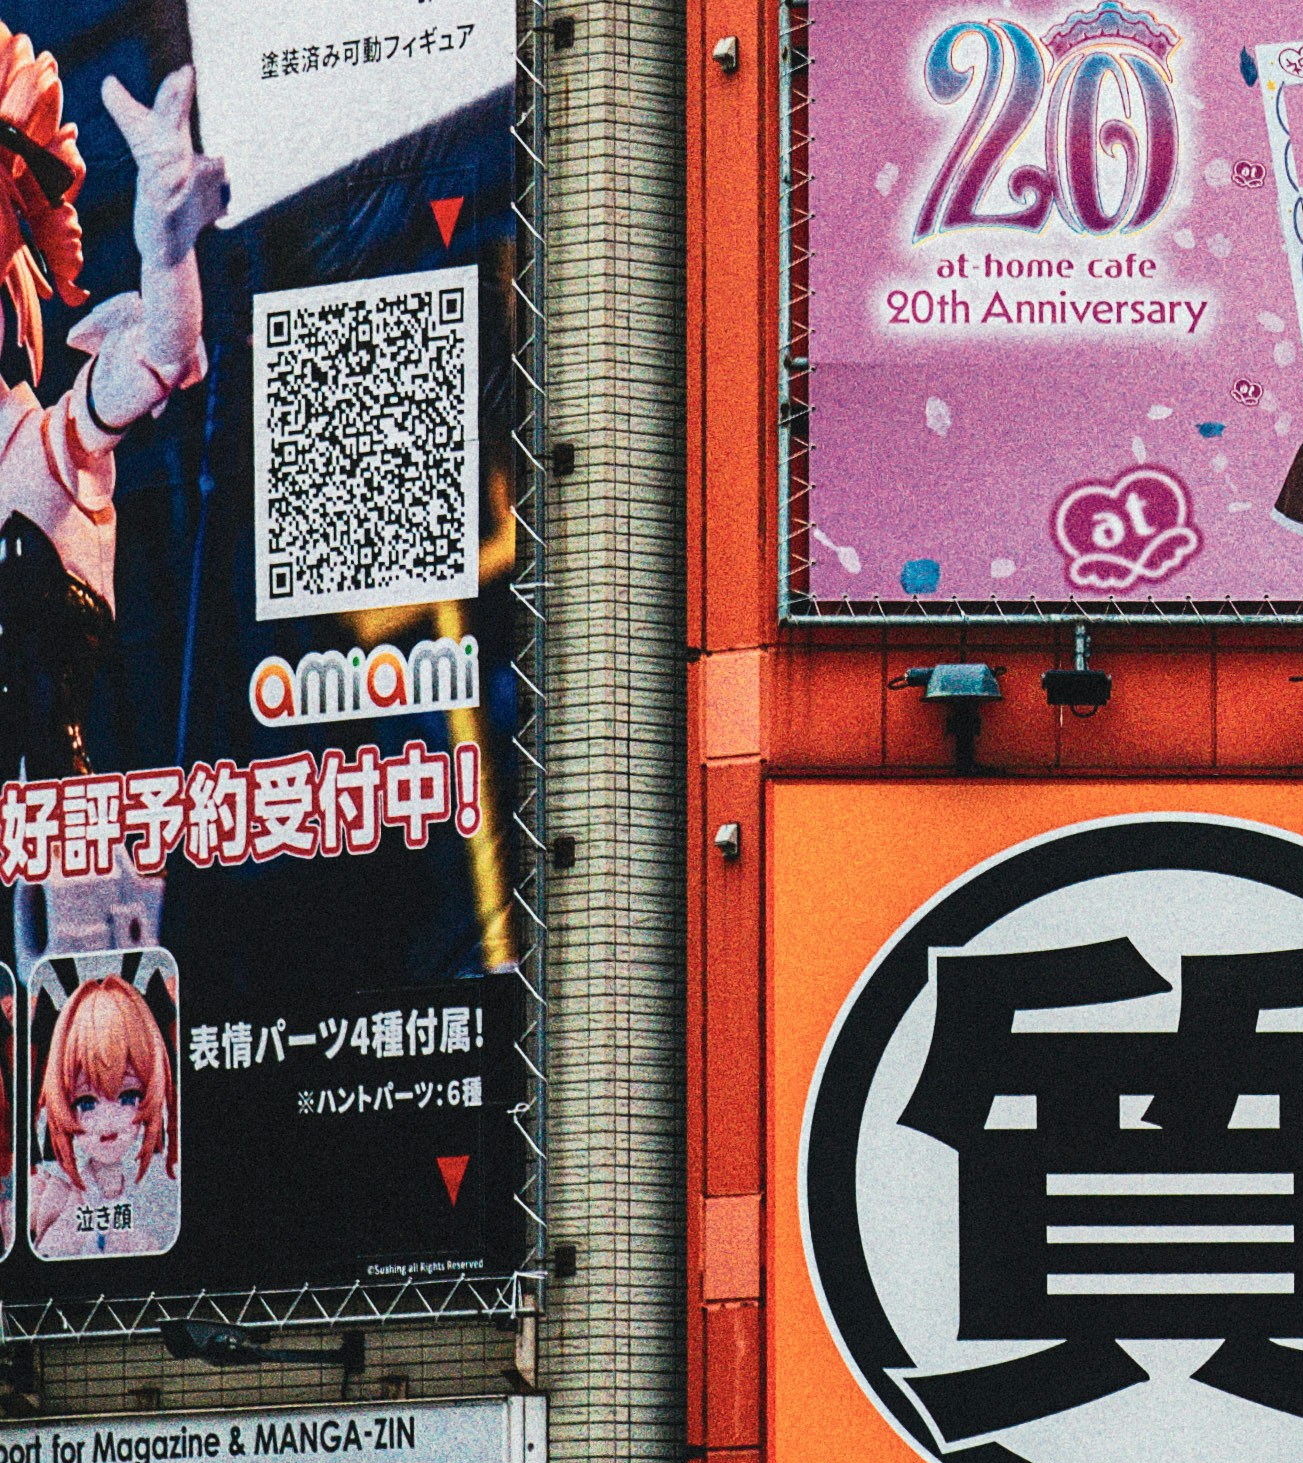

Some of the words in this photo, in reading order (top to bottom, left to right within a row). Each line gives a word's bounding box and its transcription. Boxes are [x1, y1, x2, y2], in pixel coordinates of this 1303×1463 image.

[1086, 252, 1157, 281] cafe
[885, 289, 972, 327] 20th
[980, 289, 1208, 334] Anniversary
[254, 641, 475, 720] amiami
[1, 741, 483, 886] 好評予約受付中!
[189, 1007, 484, 1071] 表情パーツ4種付属!
[75, 1204, 134, 1234] 泣き顔
[229, 1428, 246, 1457] &
[253, 1415, 416, 1456] MANGA-ZIN
